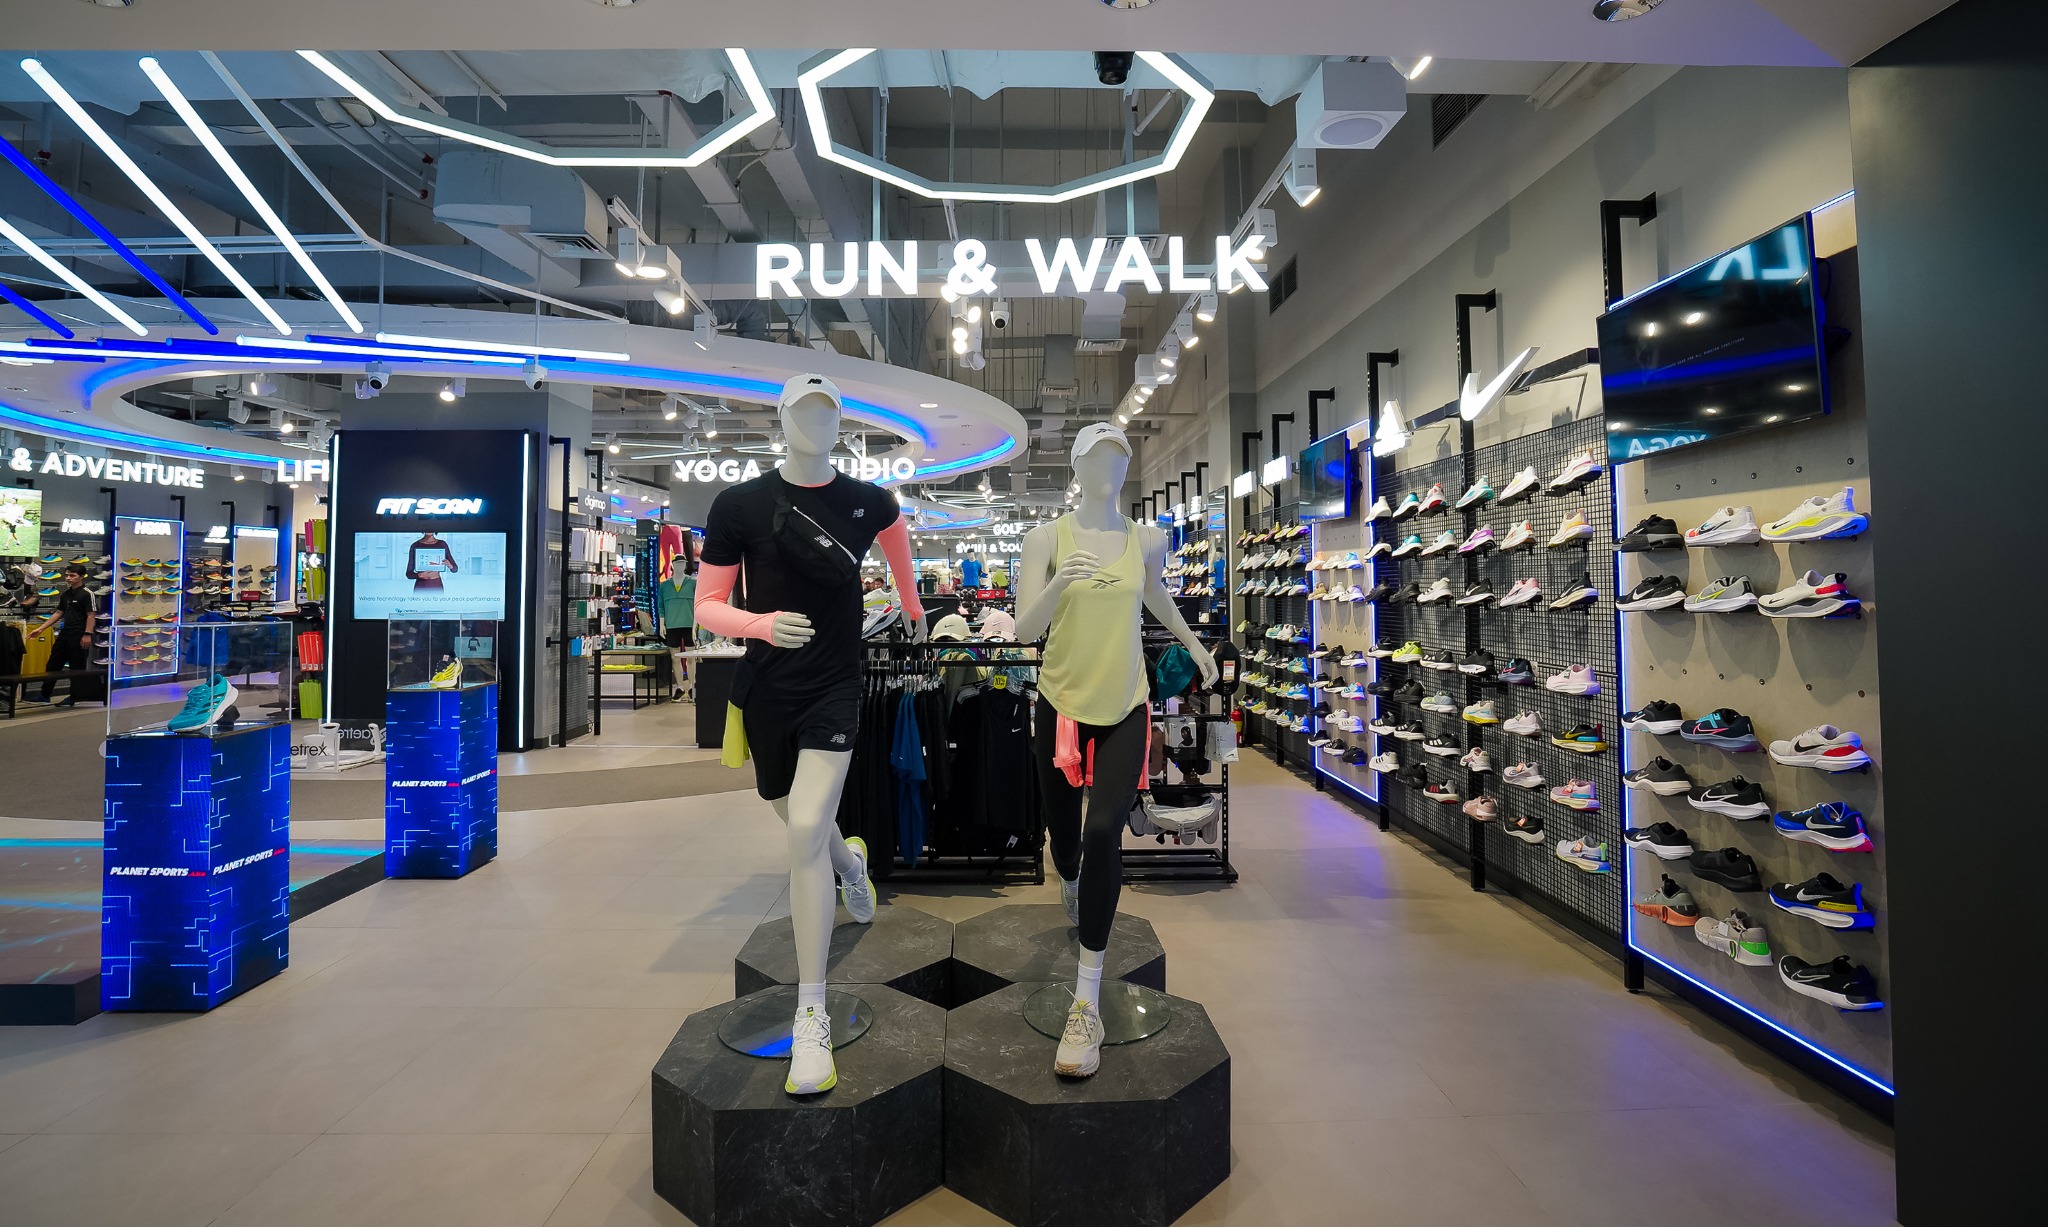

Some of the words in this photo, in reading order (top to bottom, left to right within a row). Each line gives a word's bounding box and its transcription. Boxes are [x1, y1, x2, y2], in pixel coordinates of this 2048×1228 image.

[755, 239, 918, 299] RUN
[948, 238, 999, 297] &
[1024, 234, 1270, 295] WALK
[9, 447, 33, 472] &
[40, 452, 205, 488] ADVENTURE
[675, 459, 762, 483] YOGA
[829, 457, 916, 480] UDIO
[375, 498, 417, 515] FIT
[415, 498, 483, 515] SCAN
[584, 494, 606, 513] digimap
[993, 522, 1024, 536] GOLF
[999, 541, 1023, 553] COU
[290, 743, 327, 756] etrex
[212, 858, 245, 876] PLANET
[244, 848, 273, 866] SPORTS
[110, 867, 149, 876] PLANET
[149, 867, 189, 877] SPORTS
